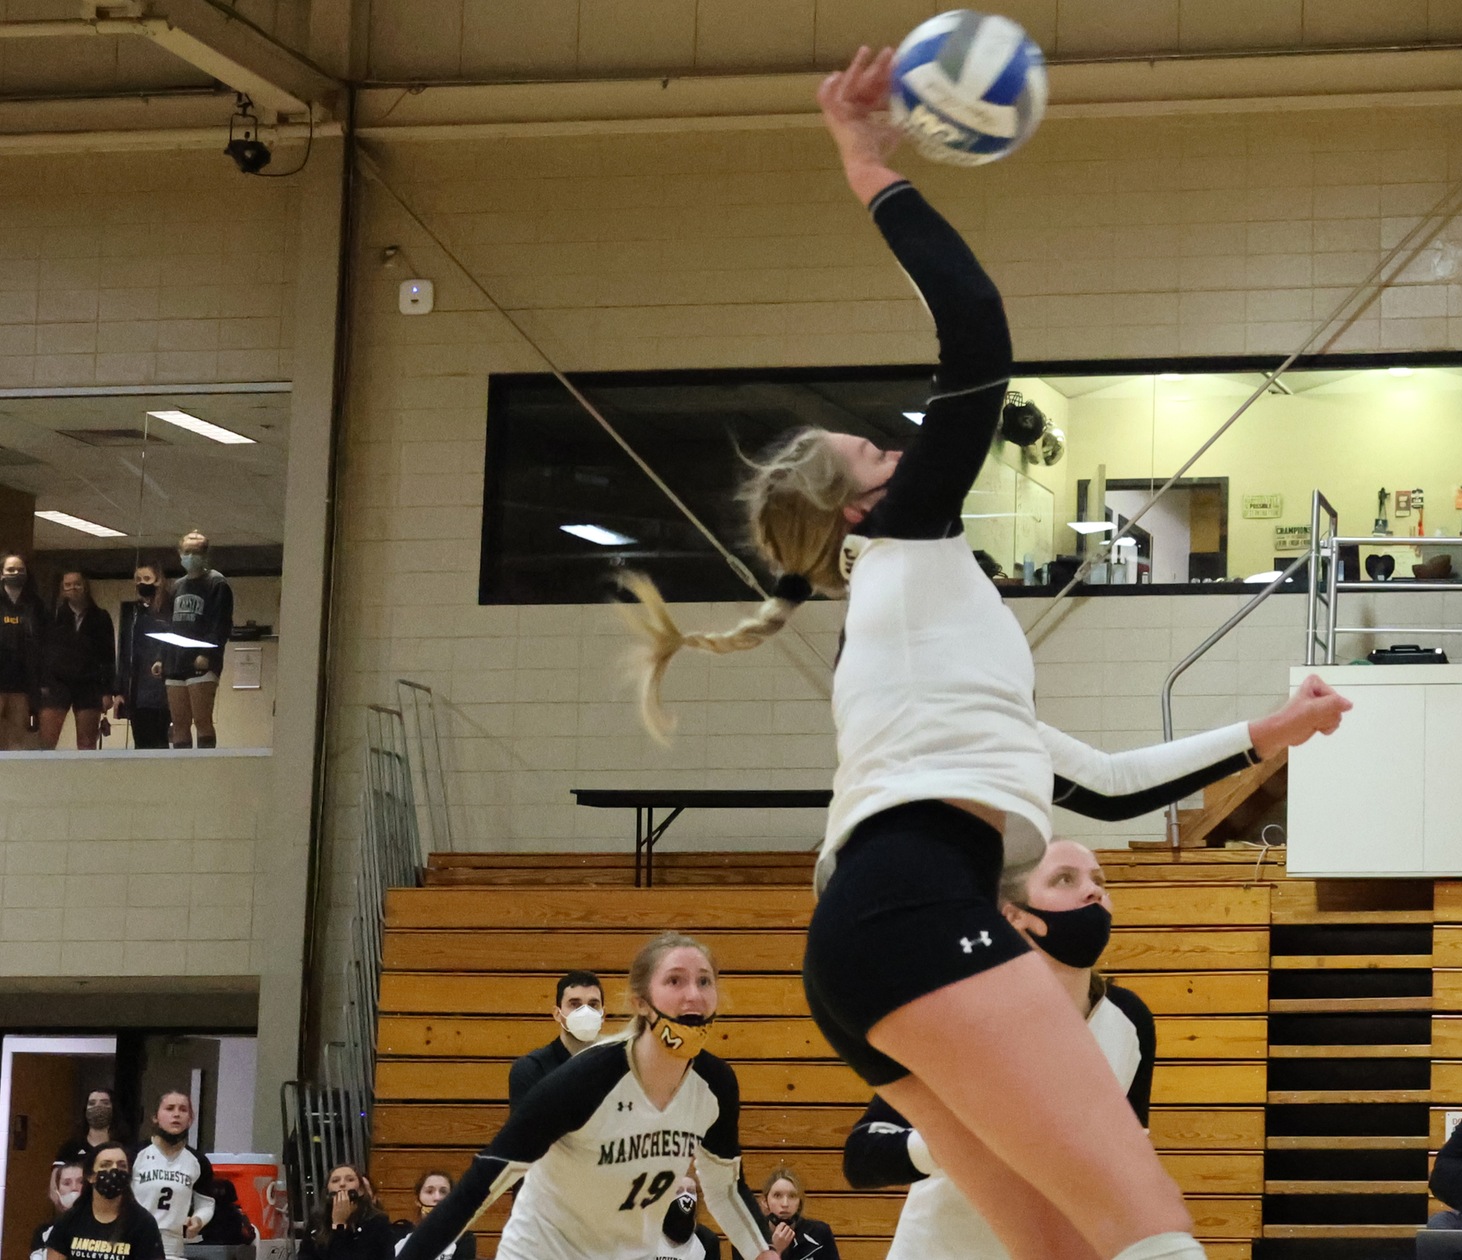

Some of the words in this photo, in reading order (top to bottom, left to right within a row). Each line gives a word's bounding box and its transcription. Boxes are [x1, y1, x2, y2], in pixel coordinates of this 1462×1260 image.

[660, 1025, 684, 1050] M
[157, 1187, 173, 1211] 2
[618, 1170, 676, 1211] 19
